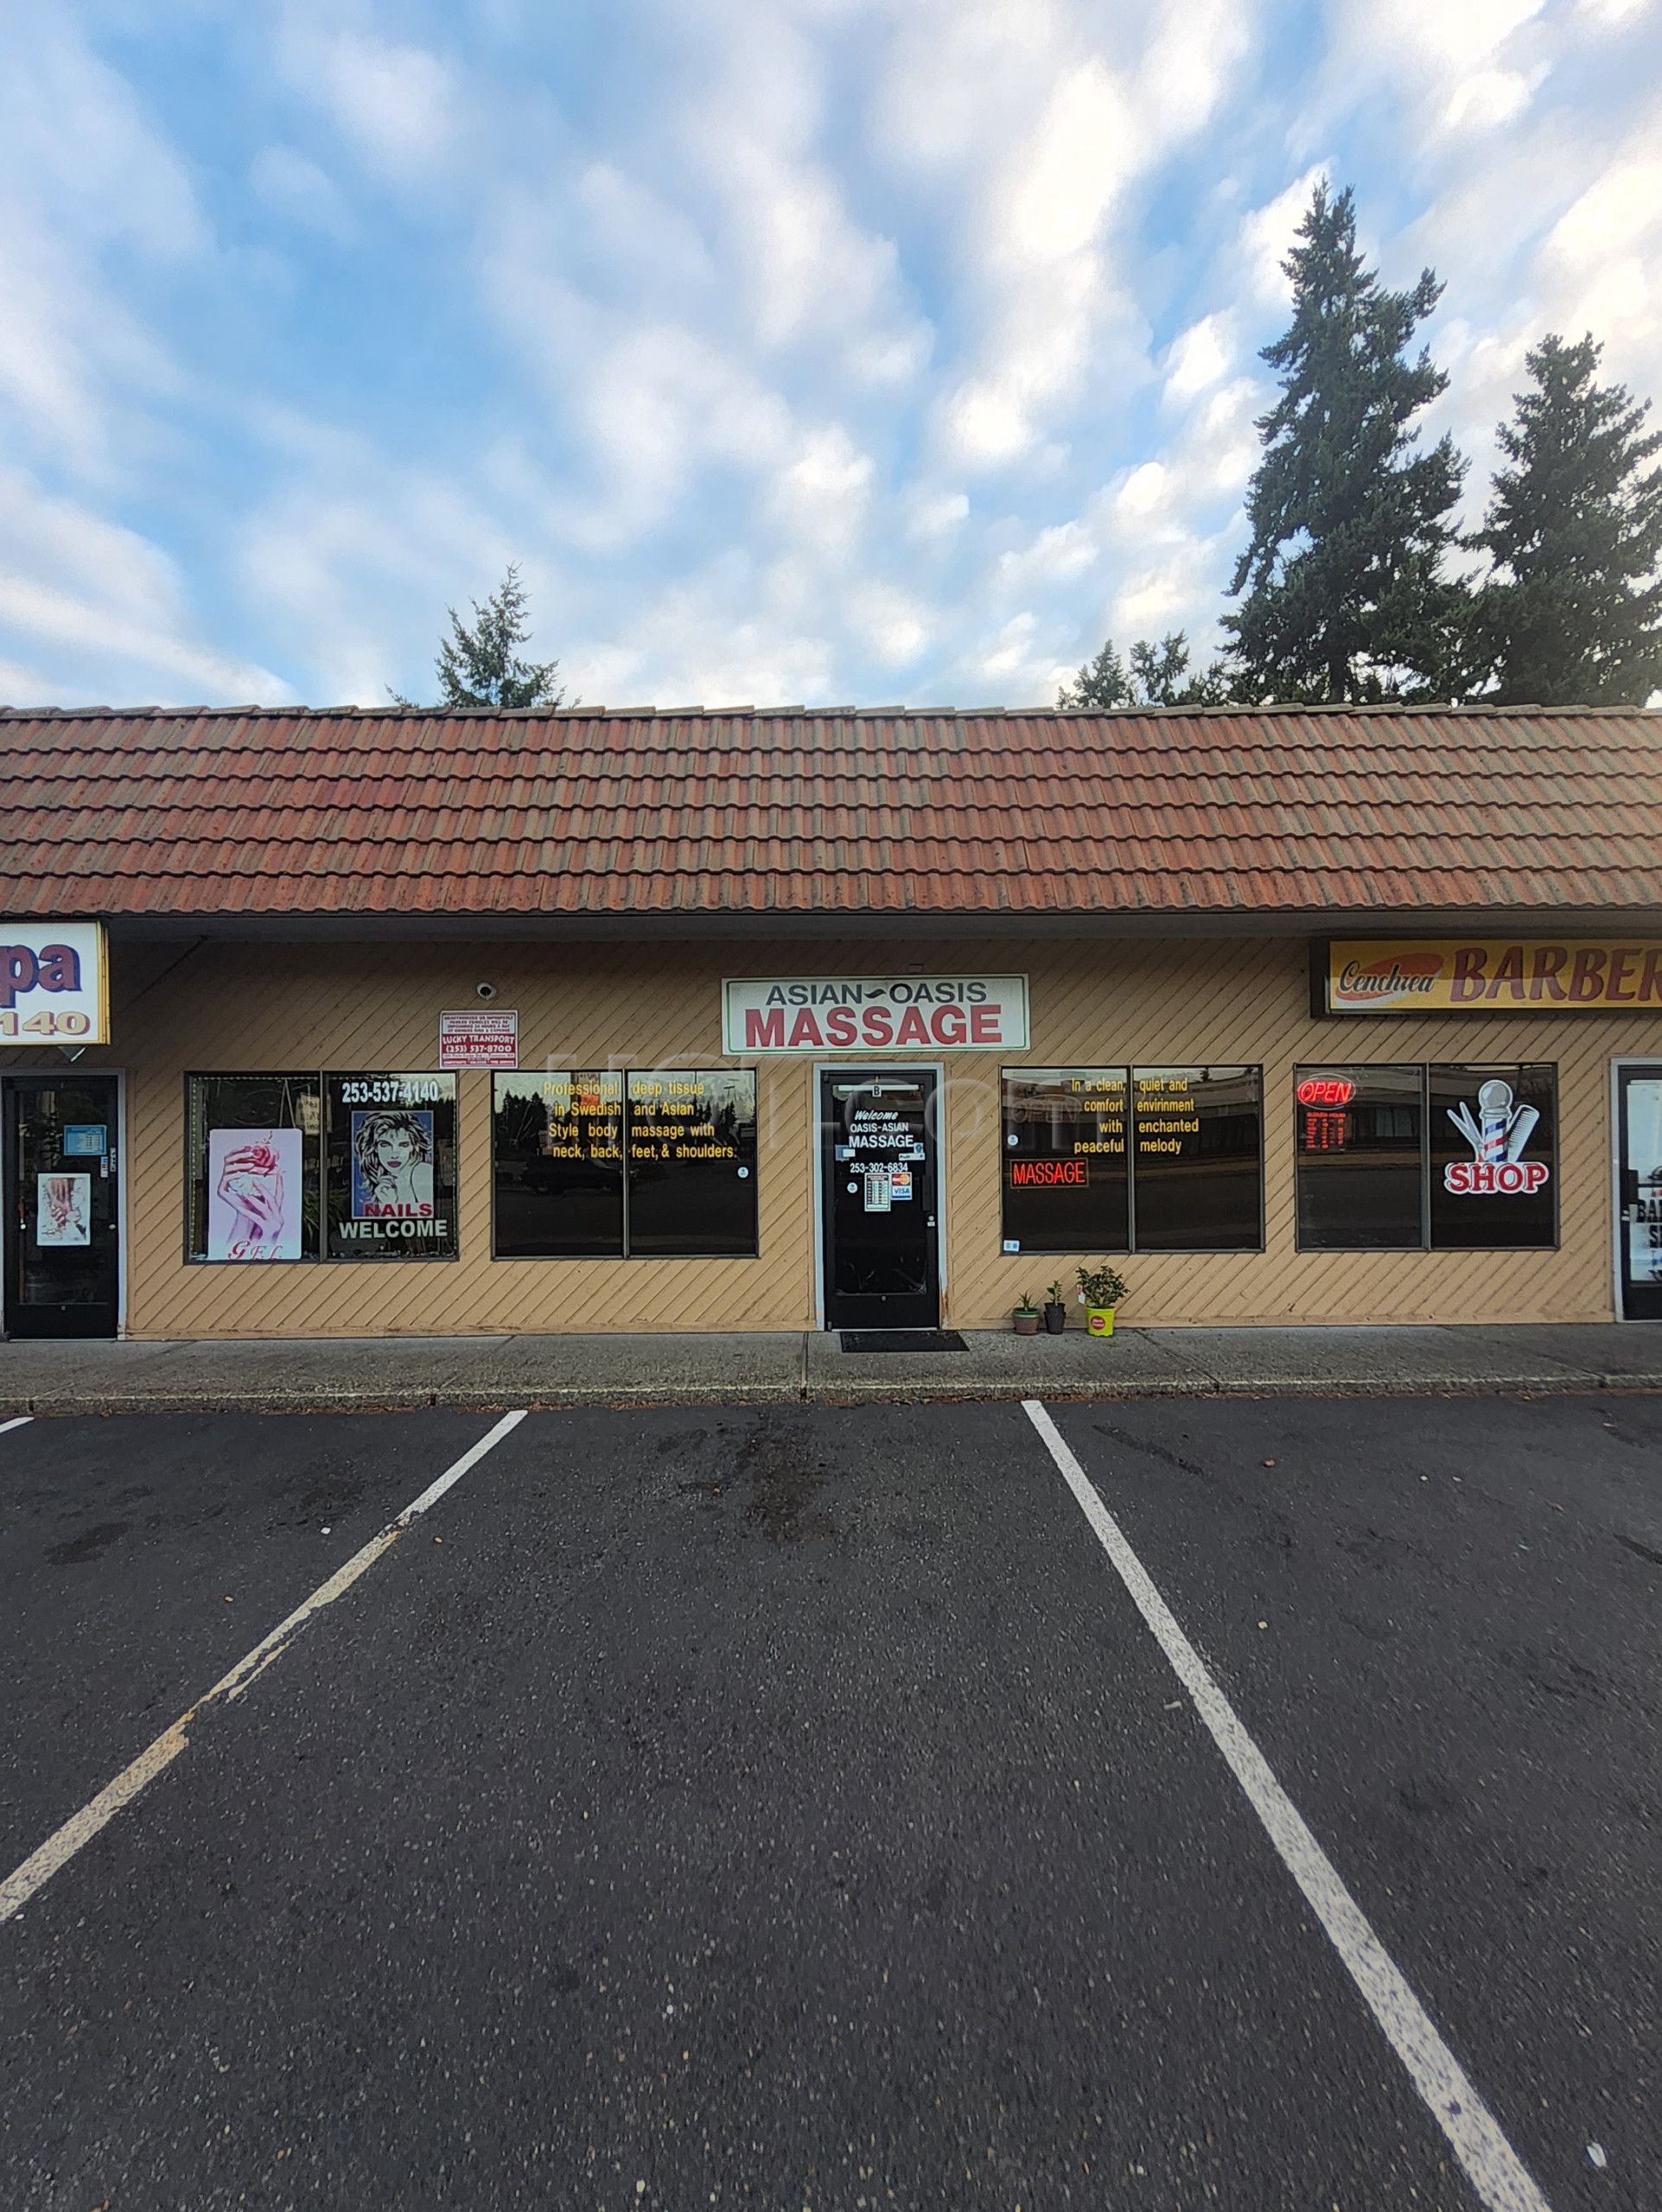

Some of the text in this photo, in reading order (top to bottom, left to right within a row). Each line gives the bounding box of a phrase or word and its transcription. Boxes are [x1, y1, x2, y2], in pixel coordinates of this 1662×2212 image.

[766, 982, 987, 1006] ASIAN OASIS
[745, 1004, 1003, 1048] MASSAGE
[443, 1034, 515, 1045] LUCKY TRANSPORT
[445, 1045, 468, 1053] (253)
[341, 1082, 438, 1103] 253-537-4140
[544, 1081, 705, 1097] Professional deep tissue
[874, 1086, 880, 1096] B
[1085, 1080, 1092, 1092] a
[1139, 1077, 1164, 1095] quiet
[1169, 1077, 1188, 1092] and
[1299, 1081, 1352, 1103] OPEN
[570, 1102, 621, 1116] Swedish
[634, 1103, 656, 1116] and
[661, 1102, 694, 1116] Asian
[1084, 1098, 1124, 1113] comfort
[855, 1109, 898, 1121] Welcome
[549, 1122, 715, 1140] Style body massage with
[850, 1122, 908, 1133] OASIS-ASIAN
[1098, 1118, 1200, 1133] with enchanted
[849, 1134, 914, 1148] MASSAGE
[1074, 1138, 1182, 1155] peaceful melody
[553, 1144, 586, 1160] neck,
[590, 1144, 623, 1160] back,
[632, 1143, 659, 1160] feet,
[661, 1144, 670, 1158] &
[850, 1162, 908, 1173] 253-302-6834
[1013, 1161, 1086, 1185] MASSAGE
[1448, 1161, 1547, 1192] SHOP
[363, 1203, 433, 1217] NAILS
[339, 1219, 449, 1239] WELCOME
